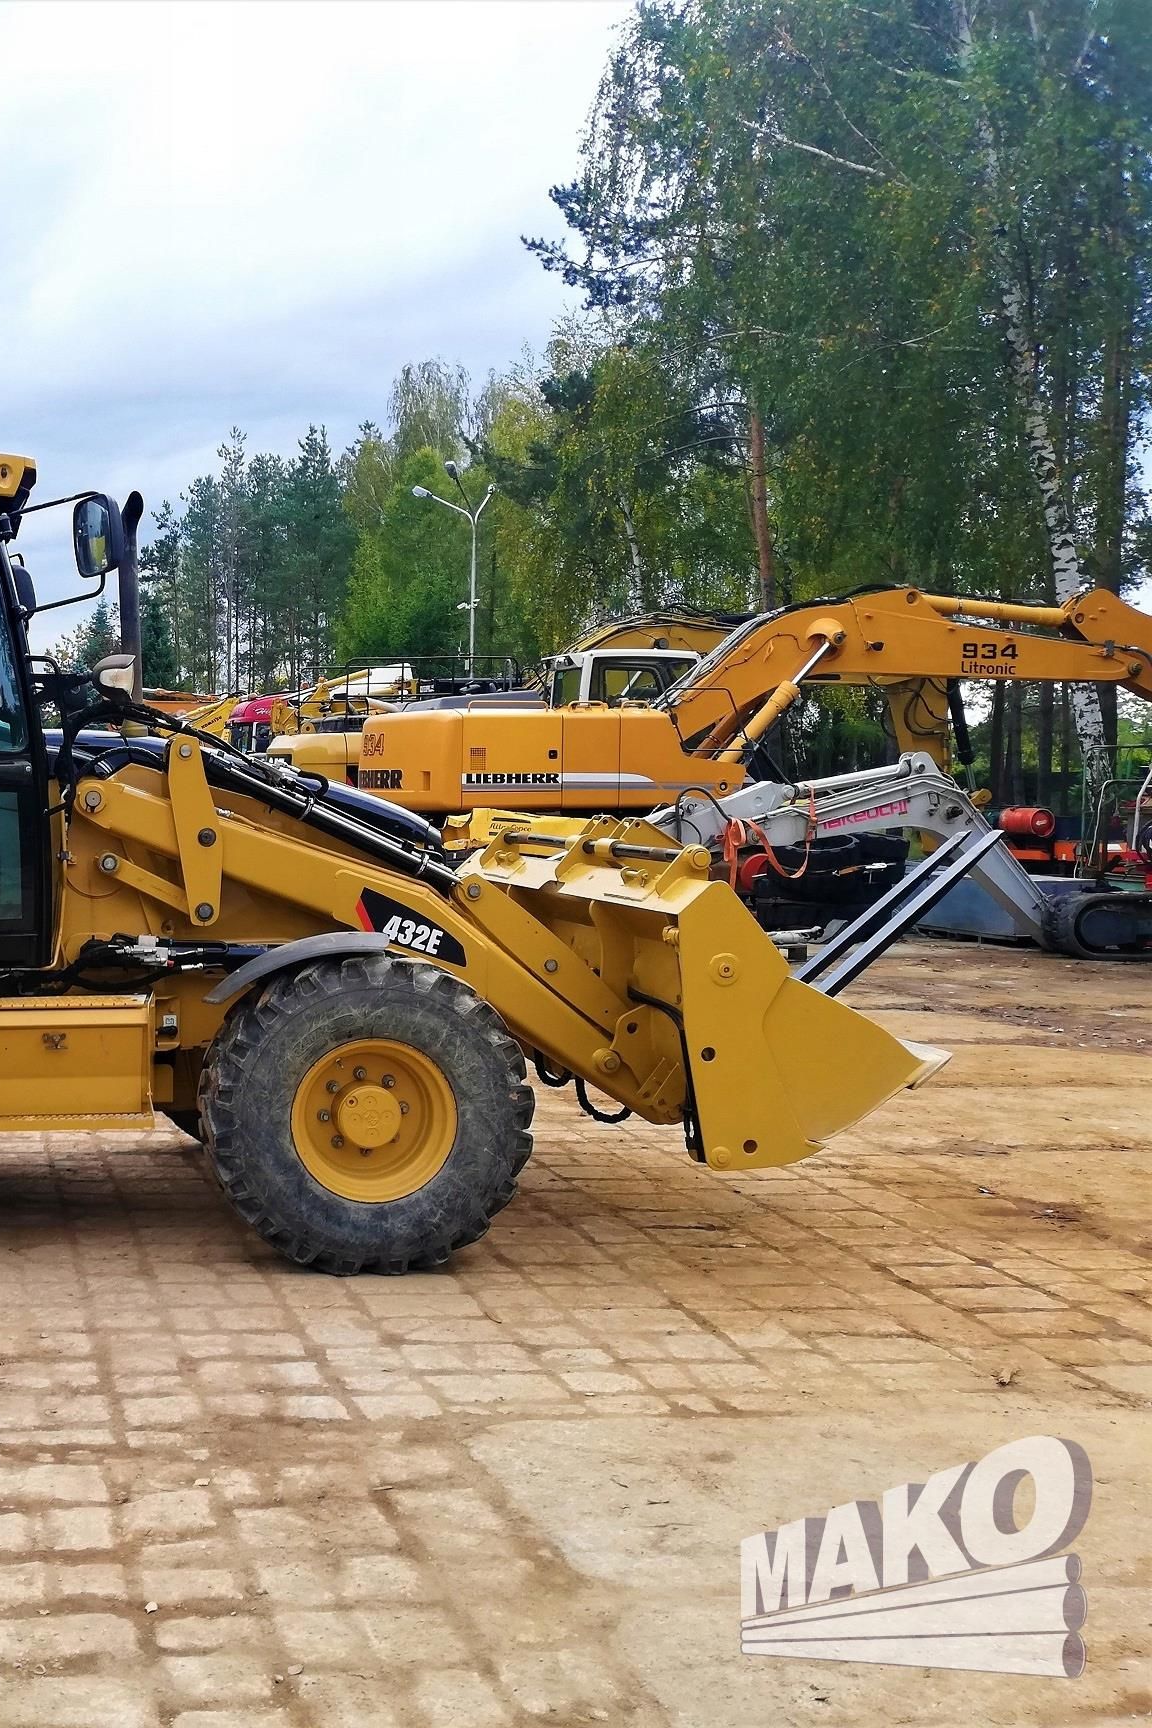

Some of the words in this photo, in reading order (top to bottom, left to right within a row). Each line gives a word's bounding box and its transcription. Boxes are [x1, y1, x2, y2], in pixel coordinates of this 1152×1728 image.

[962, 643, 1019, 659] 934
[961, 661, 1017, 675] Litronic
[363, 733, 385, 756] 934
[466, 773, 560, 784] LIEBHERR
[382, 915, 444, 955] 432E
